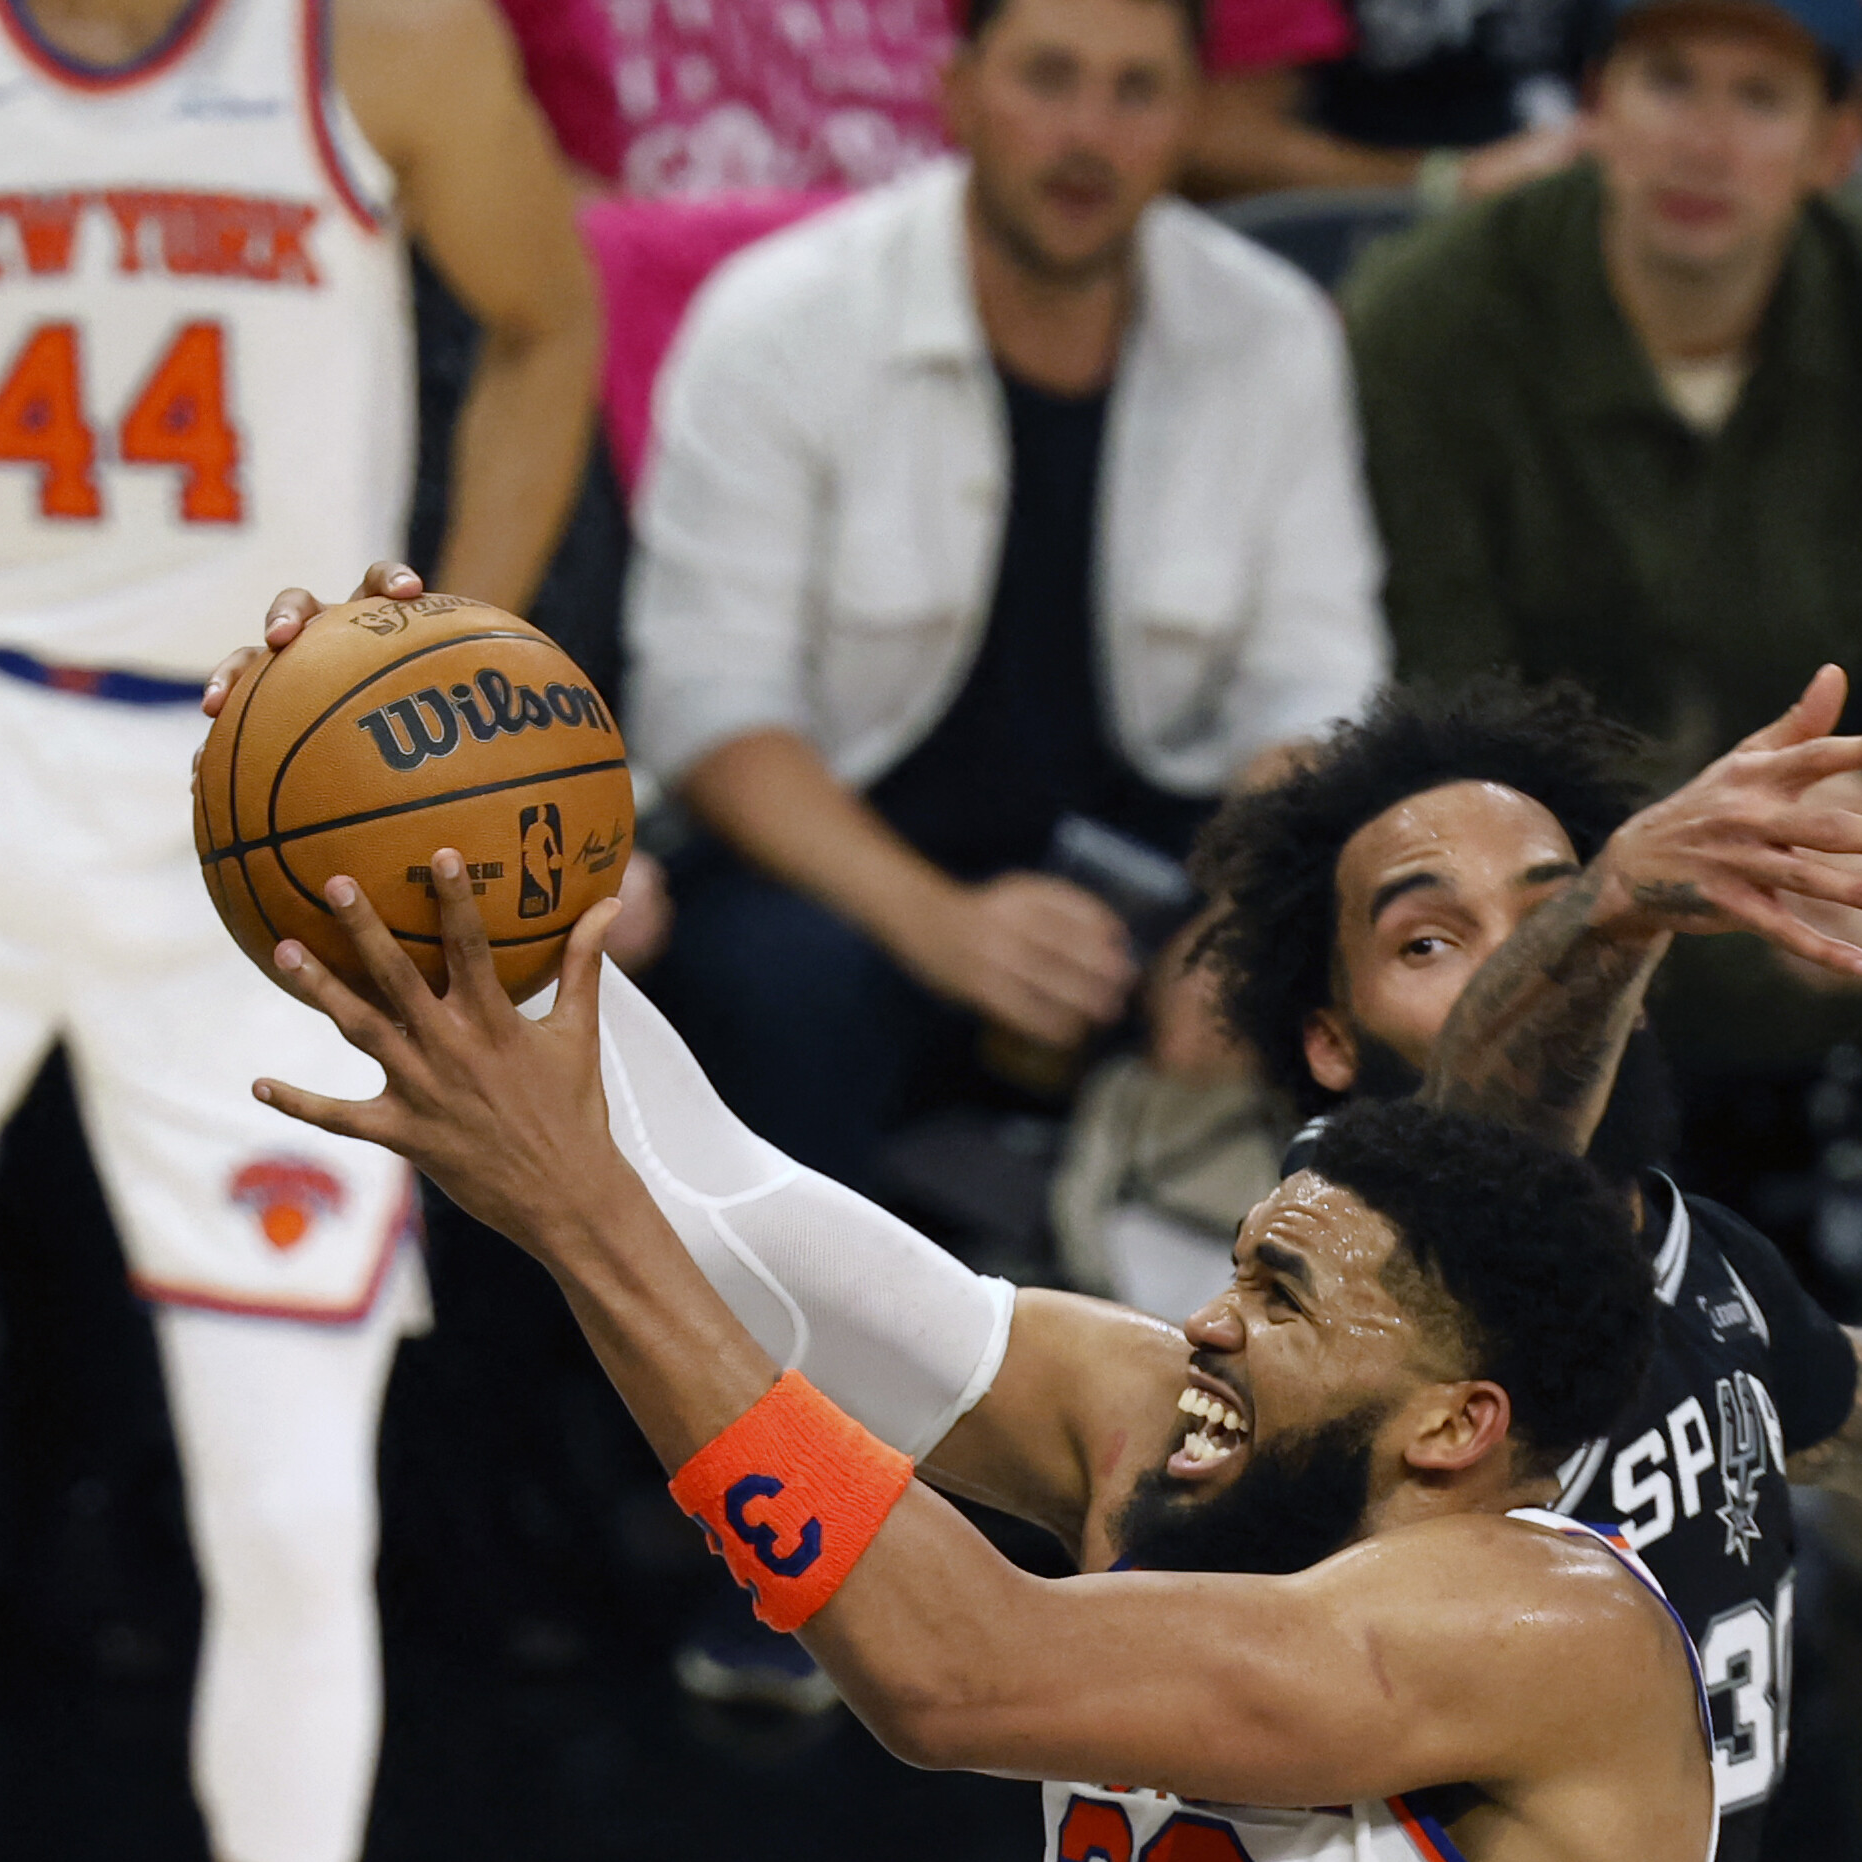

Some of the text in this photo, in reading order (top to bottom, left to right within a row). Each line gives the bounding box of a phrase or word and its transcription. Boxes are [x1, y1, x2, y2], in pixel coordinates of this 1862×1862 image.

[103, 188, 321, 288] YORK
[356, 668, 613, 772] Wilson
[724, 1472, 823, 1578] 3
[1700, 1570, 1795, 1816] 3
